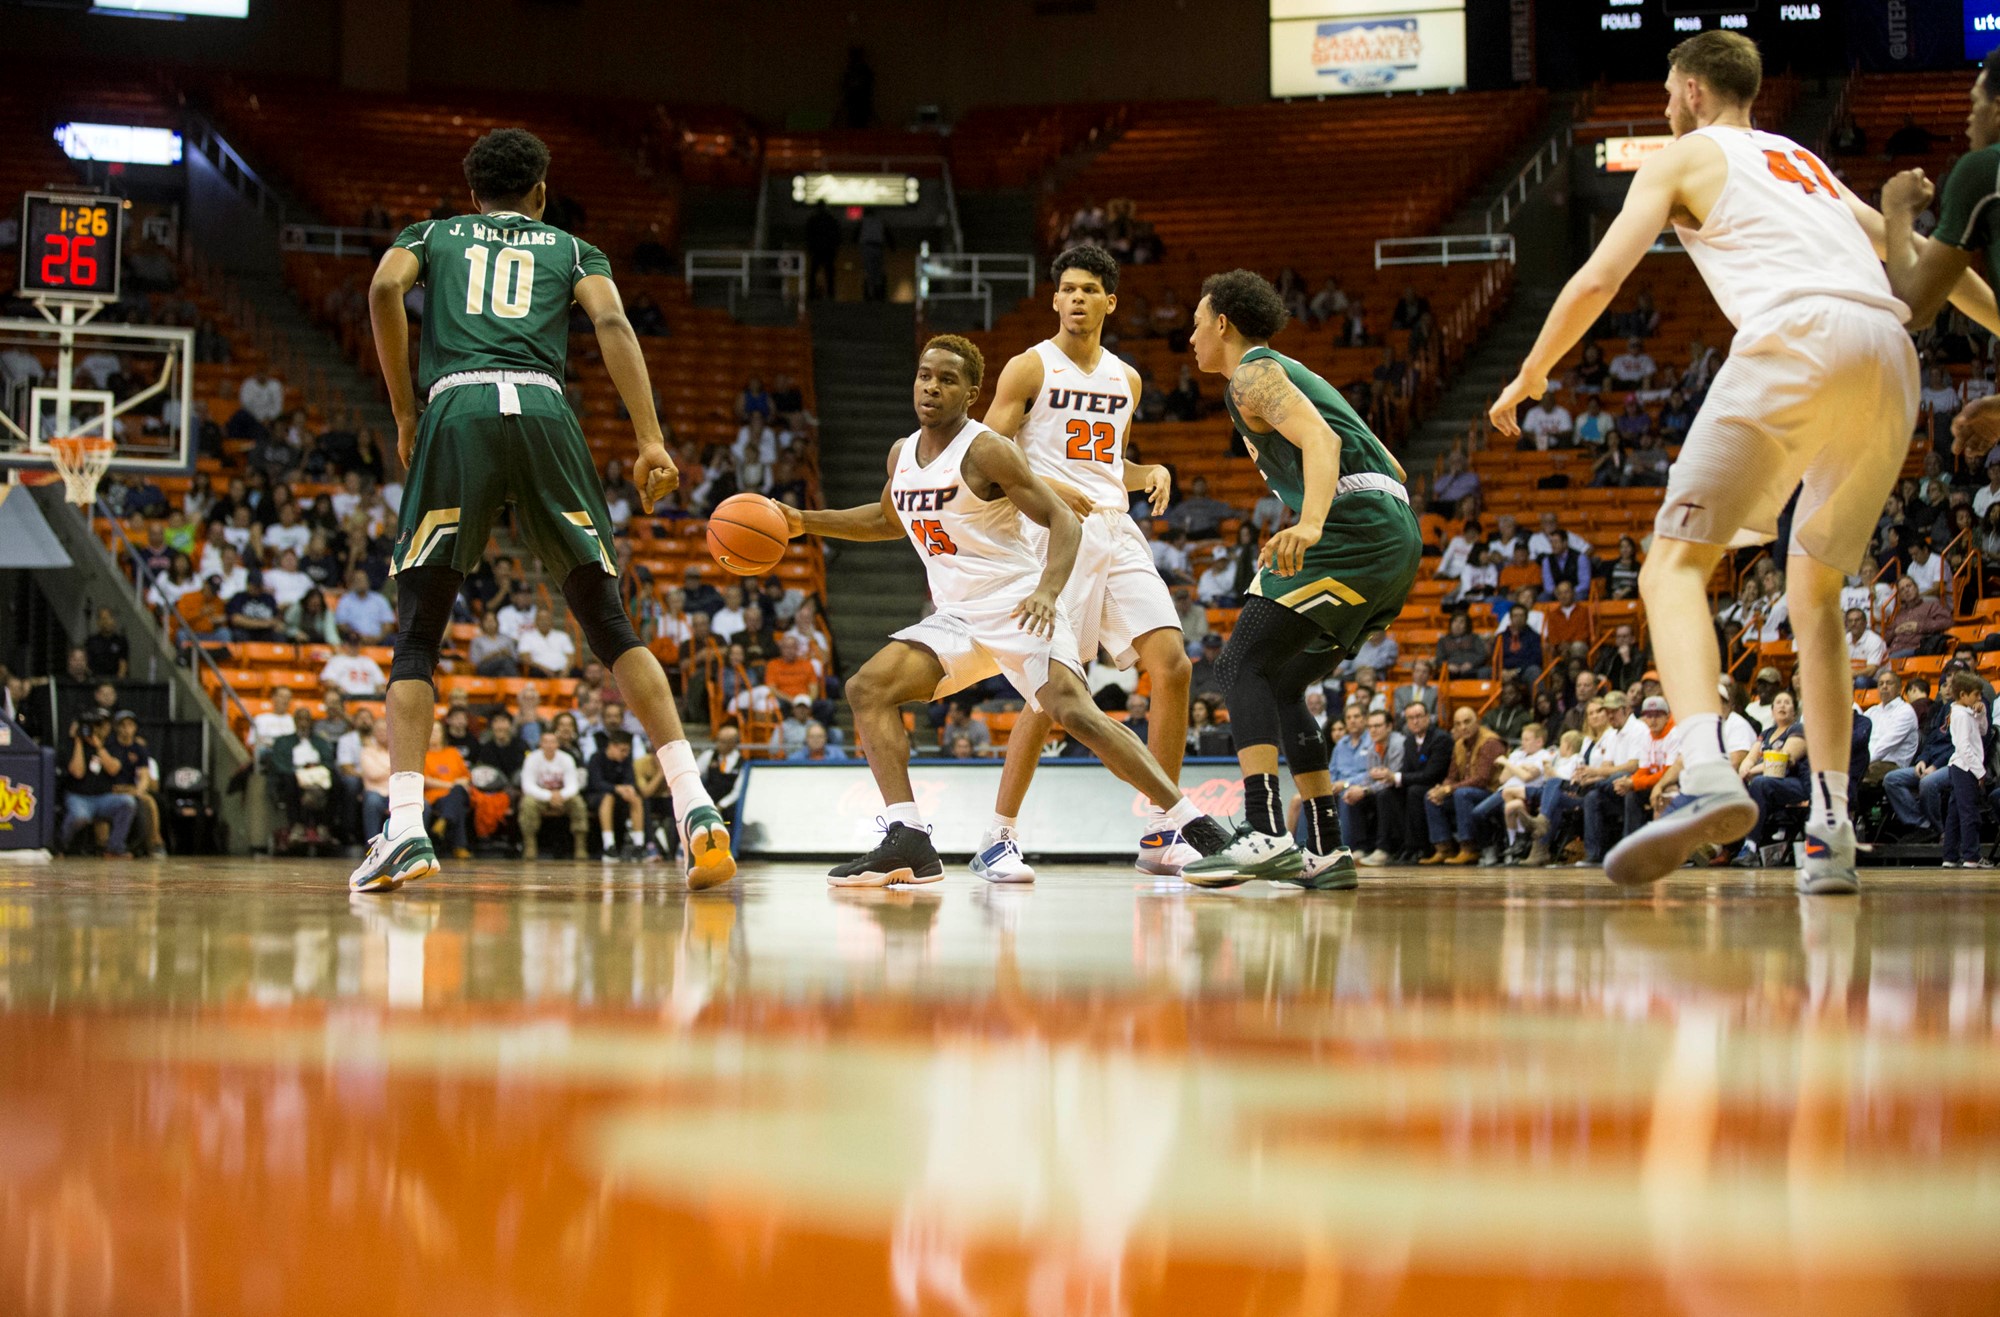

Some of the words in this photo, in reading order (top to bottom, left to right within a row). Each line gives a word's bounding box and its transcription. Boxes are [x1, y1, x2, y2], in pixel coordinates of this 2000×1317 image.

[1601, 13, 1641, 30] FOULS
[1780, 4, 1821, 20] FOULS
[1762, 149, 1840, 200] 41
[60, 207, 109, 237] 1:26
[449, 223, 465, 237] J.
[472, 222, 556, 246] WILLIAMS
[41, 234, 97, 286] 26
[465, 243, 534, 318] 10
[1049, 388, 1128, 415] UTEP
[1066, 418, 1115, 464] 22
[911, 519, 958, 557] 15
